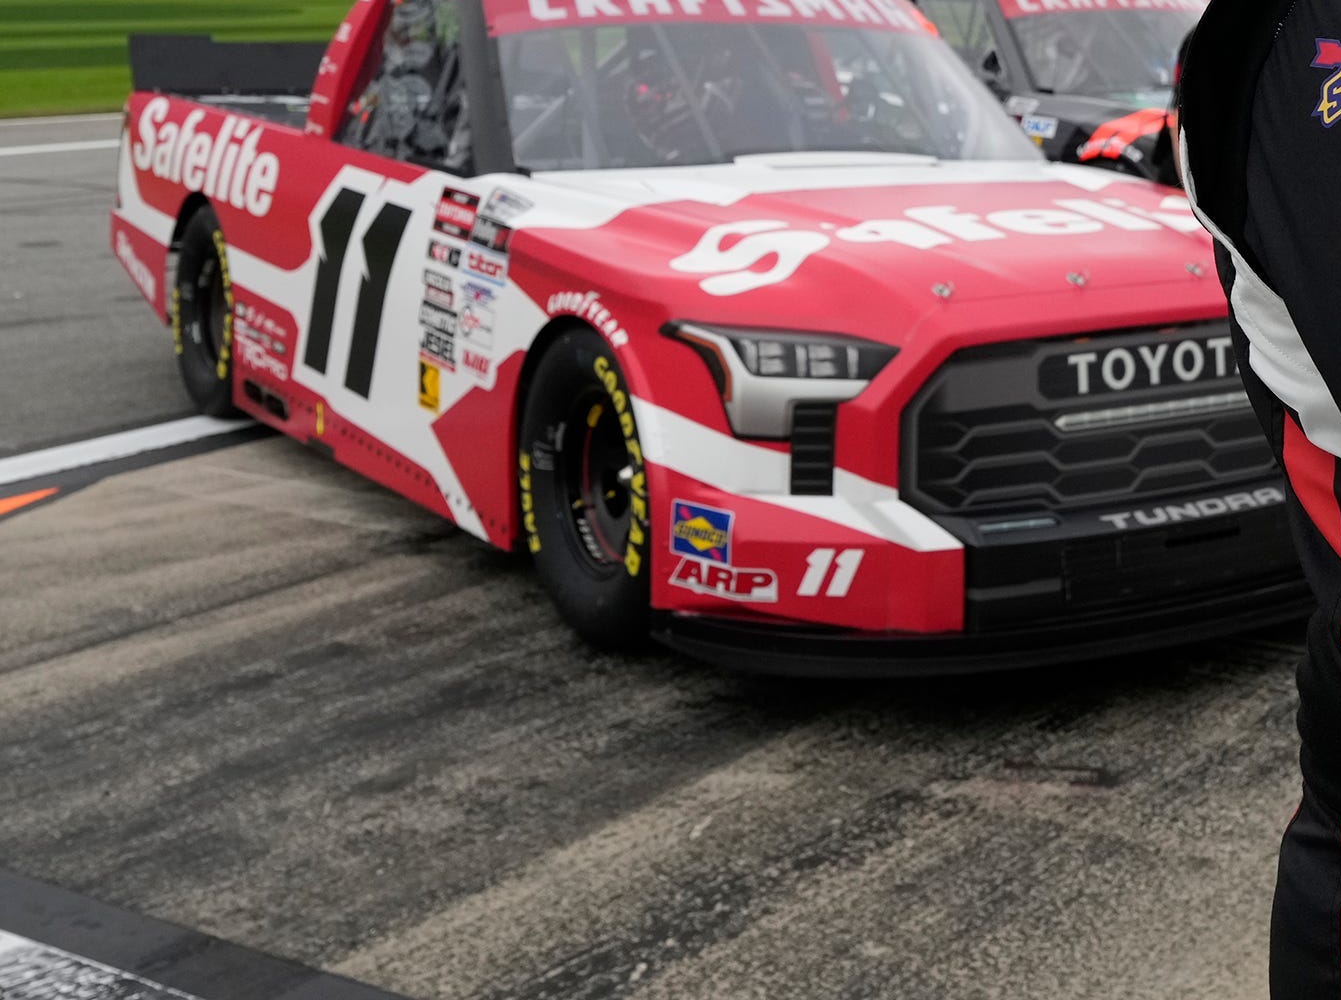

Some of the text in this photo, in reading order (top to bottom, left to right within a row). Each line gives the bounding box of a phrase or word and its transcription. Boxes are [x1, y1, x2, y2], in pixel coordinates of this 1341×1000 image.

[133, 96, 280, 218] Safelite
[303, 186, 413, 402] 11
[548, 290, 629, 348] GOODYEAR
[1067, 337, 1240, 394] TOYOT
[594, 356, 646, 577] GOODYEAR
[1100, 486, 1284, 530] TUNDRA
[675, 558, 774, 595] ARP
[797, 547, 866, 598] 11
